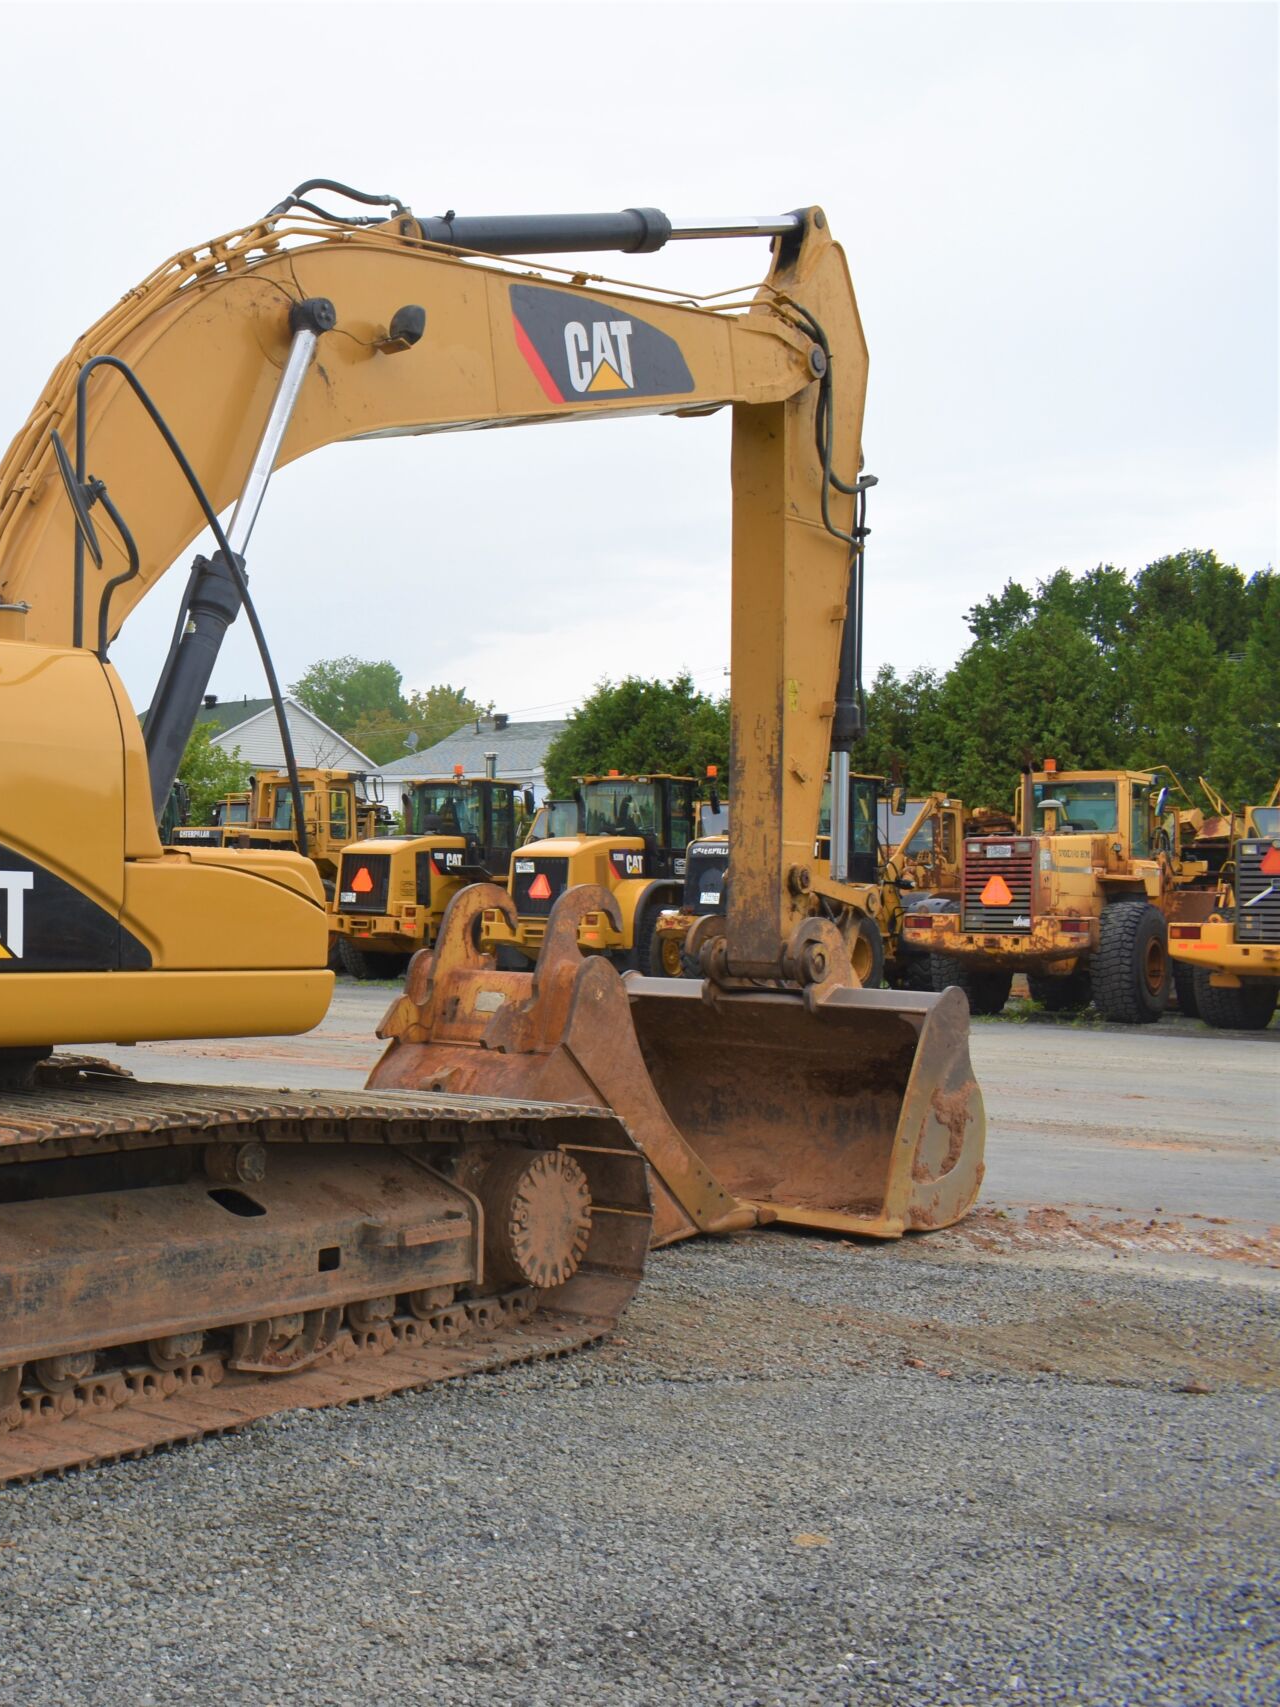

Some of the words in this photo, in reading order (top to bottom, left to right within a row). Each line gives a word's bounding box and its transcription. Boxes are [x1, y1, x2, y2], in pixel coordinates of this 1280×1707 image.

[564, 320, 634, 393] CAT
[446, 853, 463, 866] CAT
[626, 854, 643, 874] CAT
